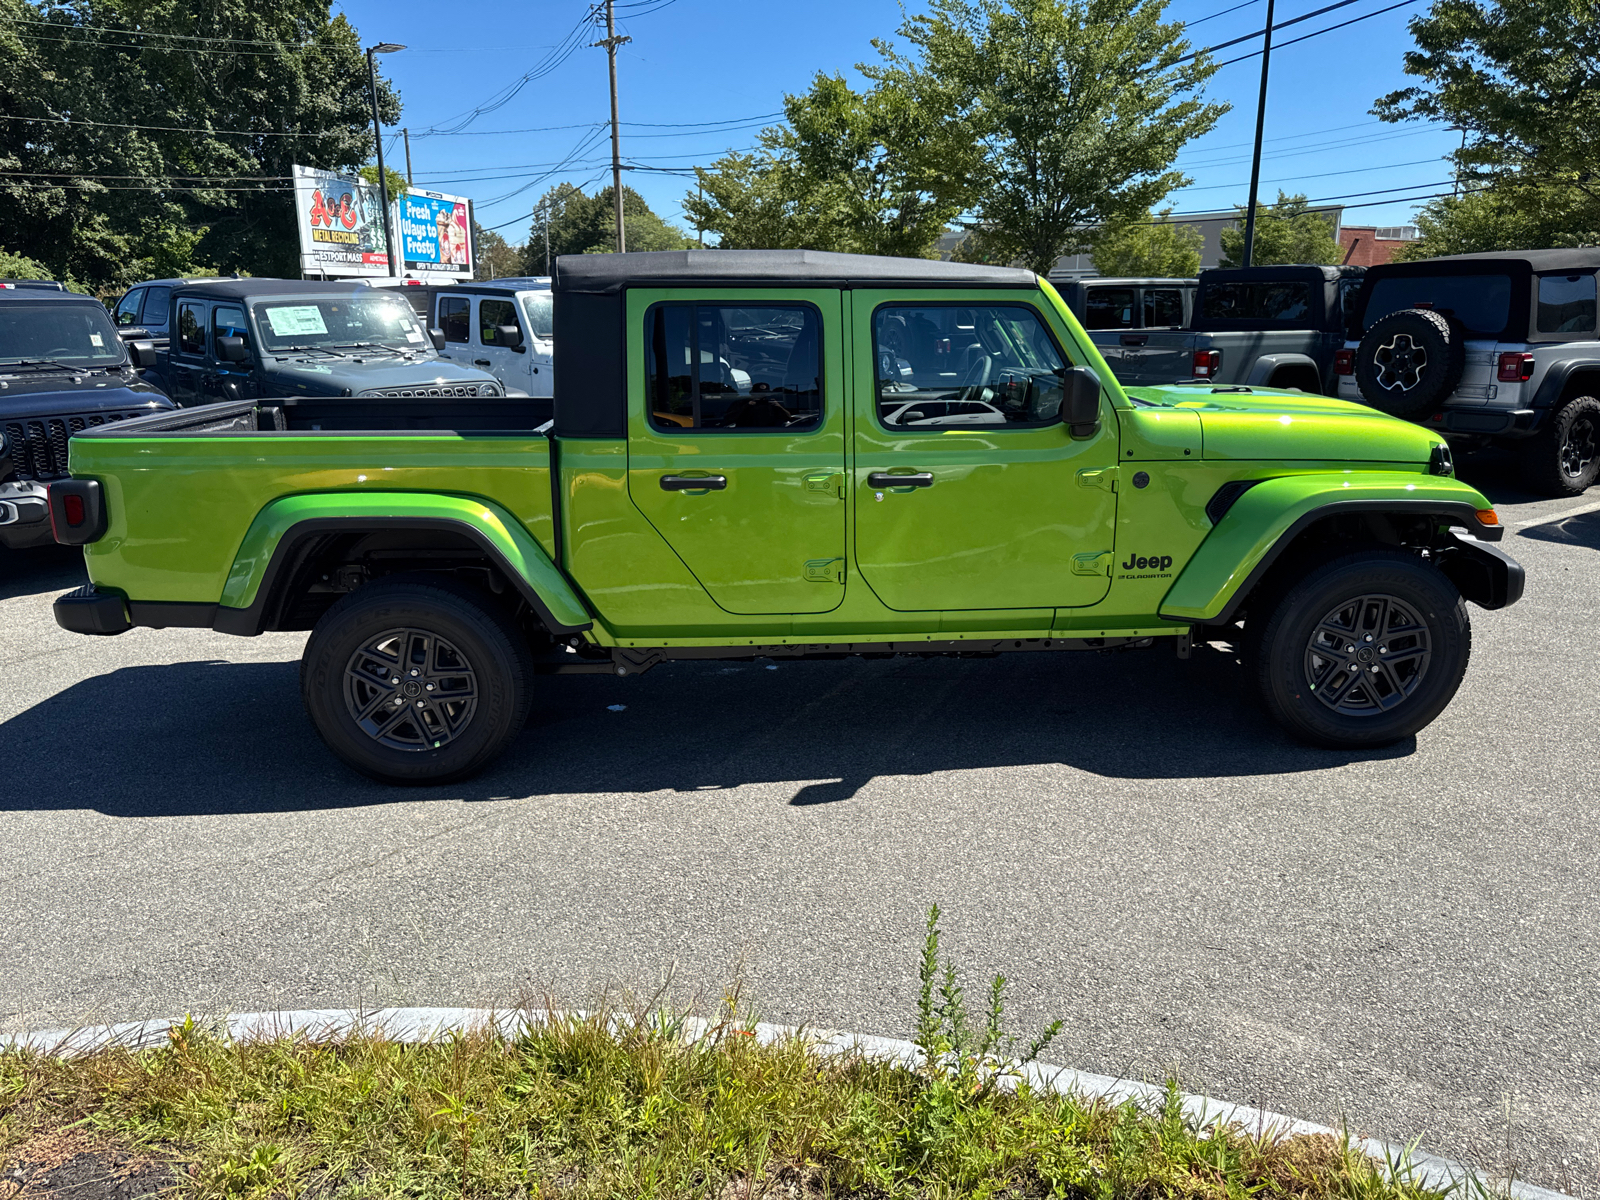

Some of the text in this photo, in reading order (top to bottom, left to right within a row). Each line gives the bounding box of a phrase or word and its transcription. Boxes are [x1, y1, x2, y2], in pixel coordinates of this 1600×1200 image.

[406, 201, 431, 220] Fresh
[313, 229, 360, 245] METAL RECYCLING
[402, 218, 437, 241] Ways to
[313, 250, 363, 263] WESTPORT MASS
[406, 236, 436, 259] Frosty
[1118, 350, 1148, 367] Jeep
[1122, 553, 1173, 571] Jeep
